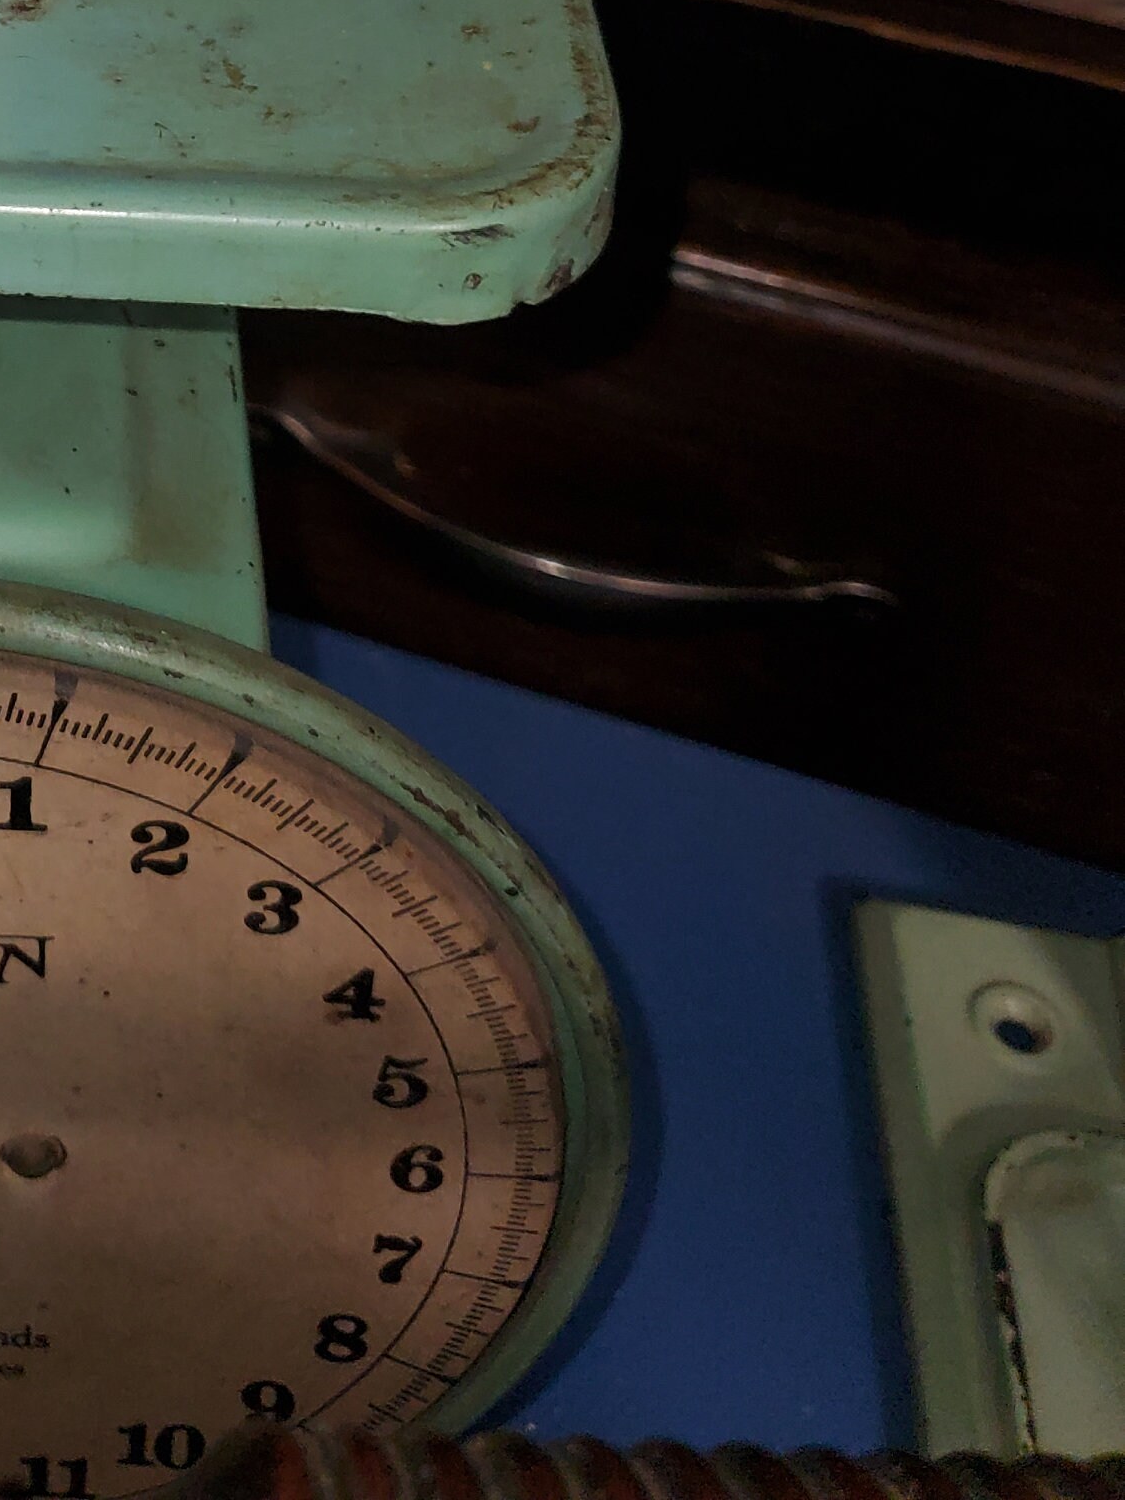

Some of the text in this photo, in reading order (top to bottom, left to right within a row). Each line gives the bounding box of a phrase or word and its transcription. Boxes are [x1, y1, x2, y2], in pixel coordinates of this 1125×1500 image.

[130, 820, 189, 875] 2
[243, 880, 304, 935] 3
[323, 967, 386, 1023] 4
[372, 1055, 430, 1110] 5
[389, 1143, 444, 1193] 6
[372, 1234, 423, 1284] 7
[313, 1313, 369, 1364] 8
[239, 1379, 295, 1423] 9
[117, 1421, 206, 1470] 10
[19, 1456, 95, 1499] 11
